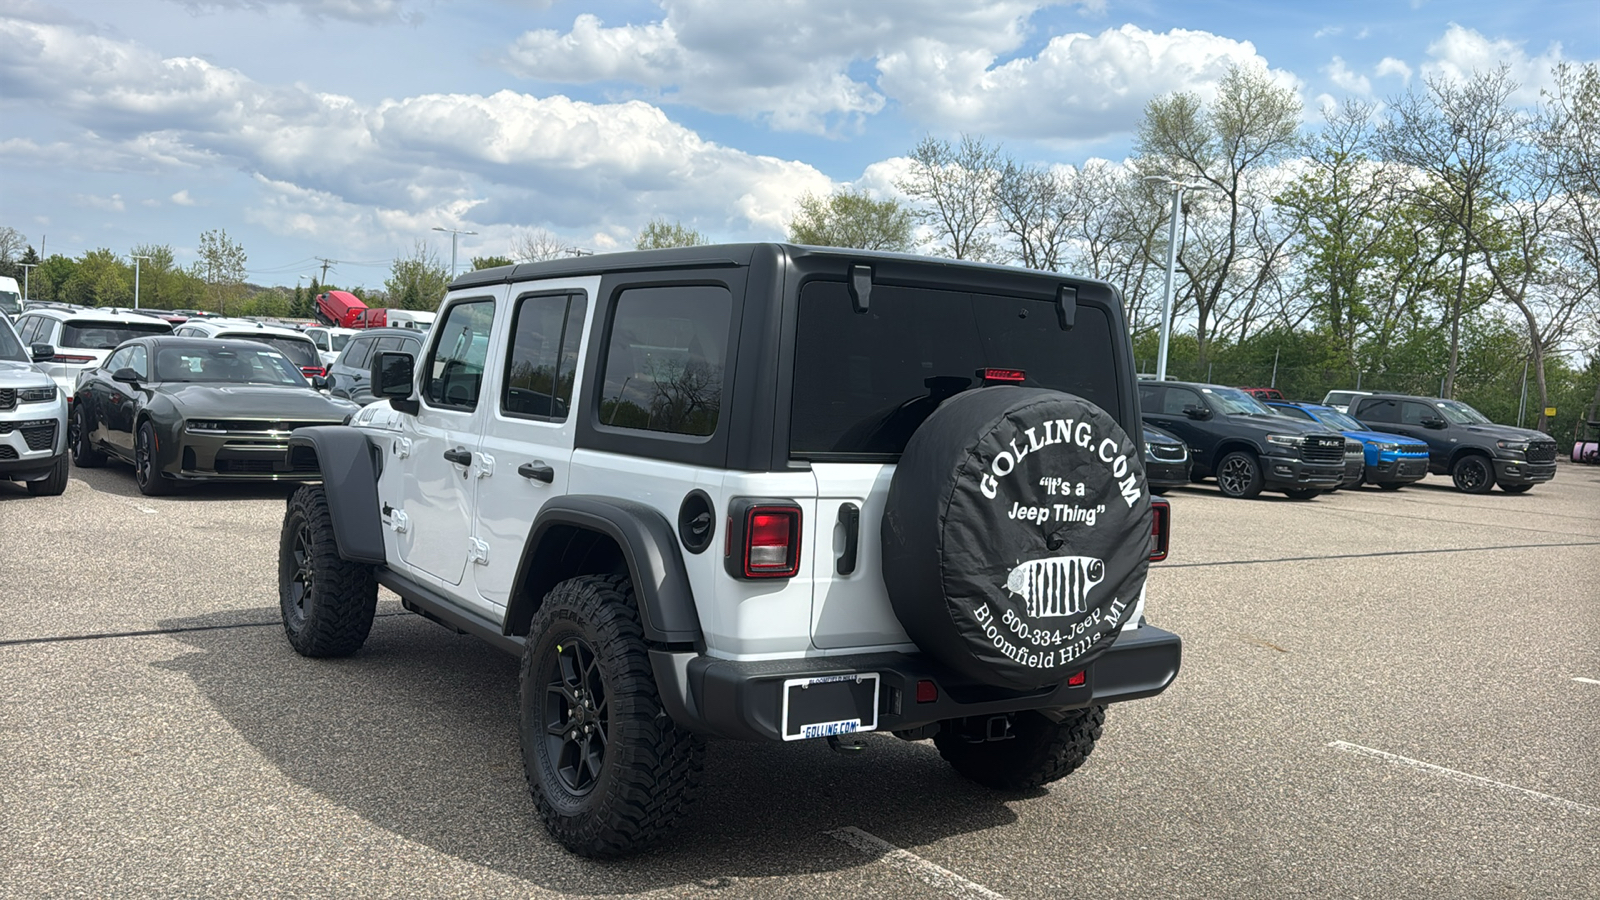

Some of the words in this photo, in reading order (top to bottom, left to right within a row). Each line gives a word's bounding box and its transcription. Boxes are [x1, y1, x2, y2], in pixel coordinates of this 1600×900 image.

[979, 419, 1141, 508] GOLLING.COM
[1074, 482, 1086, 496] a
[1008, 501, 1050, 526] Jeep
[973, 602, 1055, 669] Bloomfield
[1103, 597, 1127, 629] MI
[1001, 607, 1101, 647] 800-334-Jeep
[806, 721, 857, 738] GOLLING.COM
